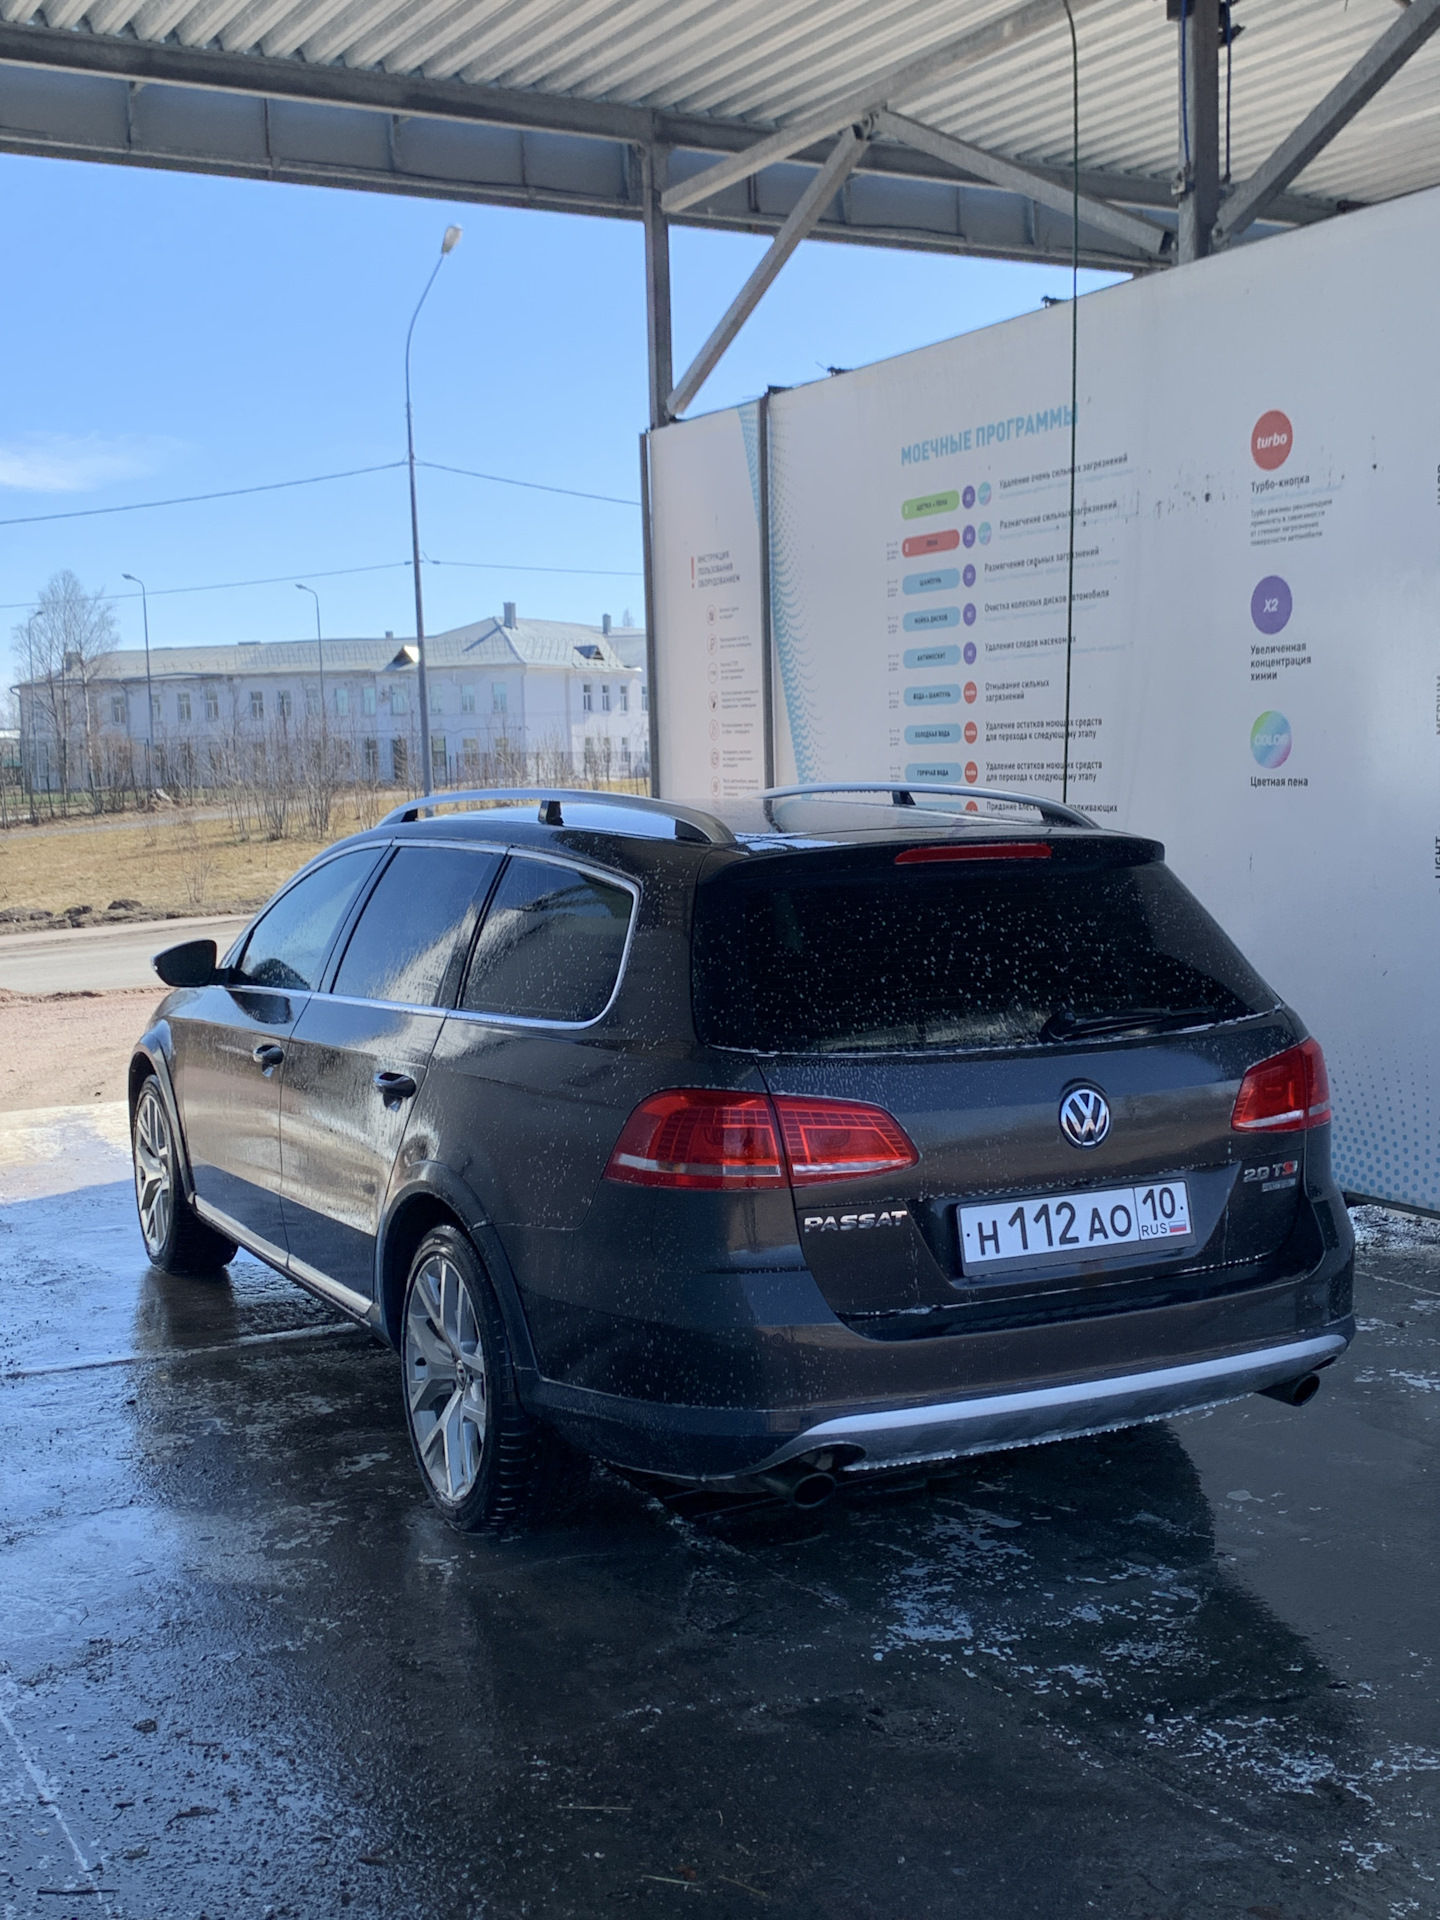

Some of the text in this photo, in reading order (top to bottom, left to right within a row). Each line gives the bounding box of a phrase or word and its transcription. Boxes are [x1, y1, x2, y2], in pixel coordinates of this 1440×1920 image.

[901, 402, 1078, 466] МОЕЧНЫЕ ПРОГРАММЫ
[1256, 432, 1287, 450] turbo
[1000, 476, 1030, 490] Удаление
[1032, 472, 1050, 483] очень
[1052, 463, 1081, 478] сильнх
[1083, 452, 1128, 472] загрязнений
[1251, 474, 1310, 494] Турбо-кнопка
[1000, 515, 1041, 530] Размягчение
[984, 560, 1025, 573] Размягчение
[1056, 546, 1099, 562] загрзнений
[984, 601, 1010, 613] Очистка
[1011, 596, 1042, 611] колесных
[1043, 594, 1067, 606] дисков
[1070, 589, 1109, 603] втомобиля
[1263, 598, 1278, 612] X2
[985, 635, 1076, 652] Удаление следов насекомх
[1251, 643, 1307, 655] Увеличенная
[1251, 655, 1312, 669] концентрация
[1251, 672, 1277, 681] химии
[985, 679, 1049, 691] Отмывание сильных
[985, 691, 1025, 703] загрязнений
[986, 718, 1102, 731] Удаление остатков моющх средств
[986, 733, 997, 742] для
[999, 731, 1027, 742] перехода
[1034, 730, 1076, 741] следующму
[1078, 730, 1097, 740] этапу
[1254, 734, 1288, 746] COLOR
[986, 761, 1015, 771] Удаление
[1017, 761, 1044, 770] остатков
[1075, 761, 1103, 771] средств
[986, 773, 997, 782] для
[999, 773, 1027, 782] перехода
[1034, 772, 1076, 782] следующму
[1078, 772, 1097, 782] этапу
[1251, 776, 1308, 788] Цветная пена
[987, 801, 1017, 812] Придание
[1142, 1187, 1176, 1221] 10
[804, 1210, 908, 1233] PASSAT
[1142, 1222, 1168, 1236] RUS
